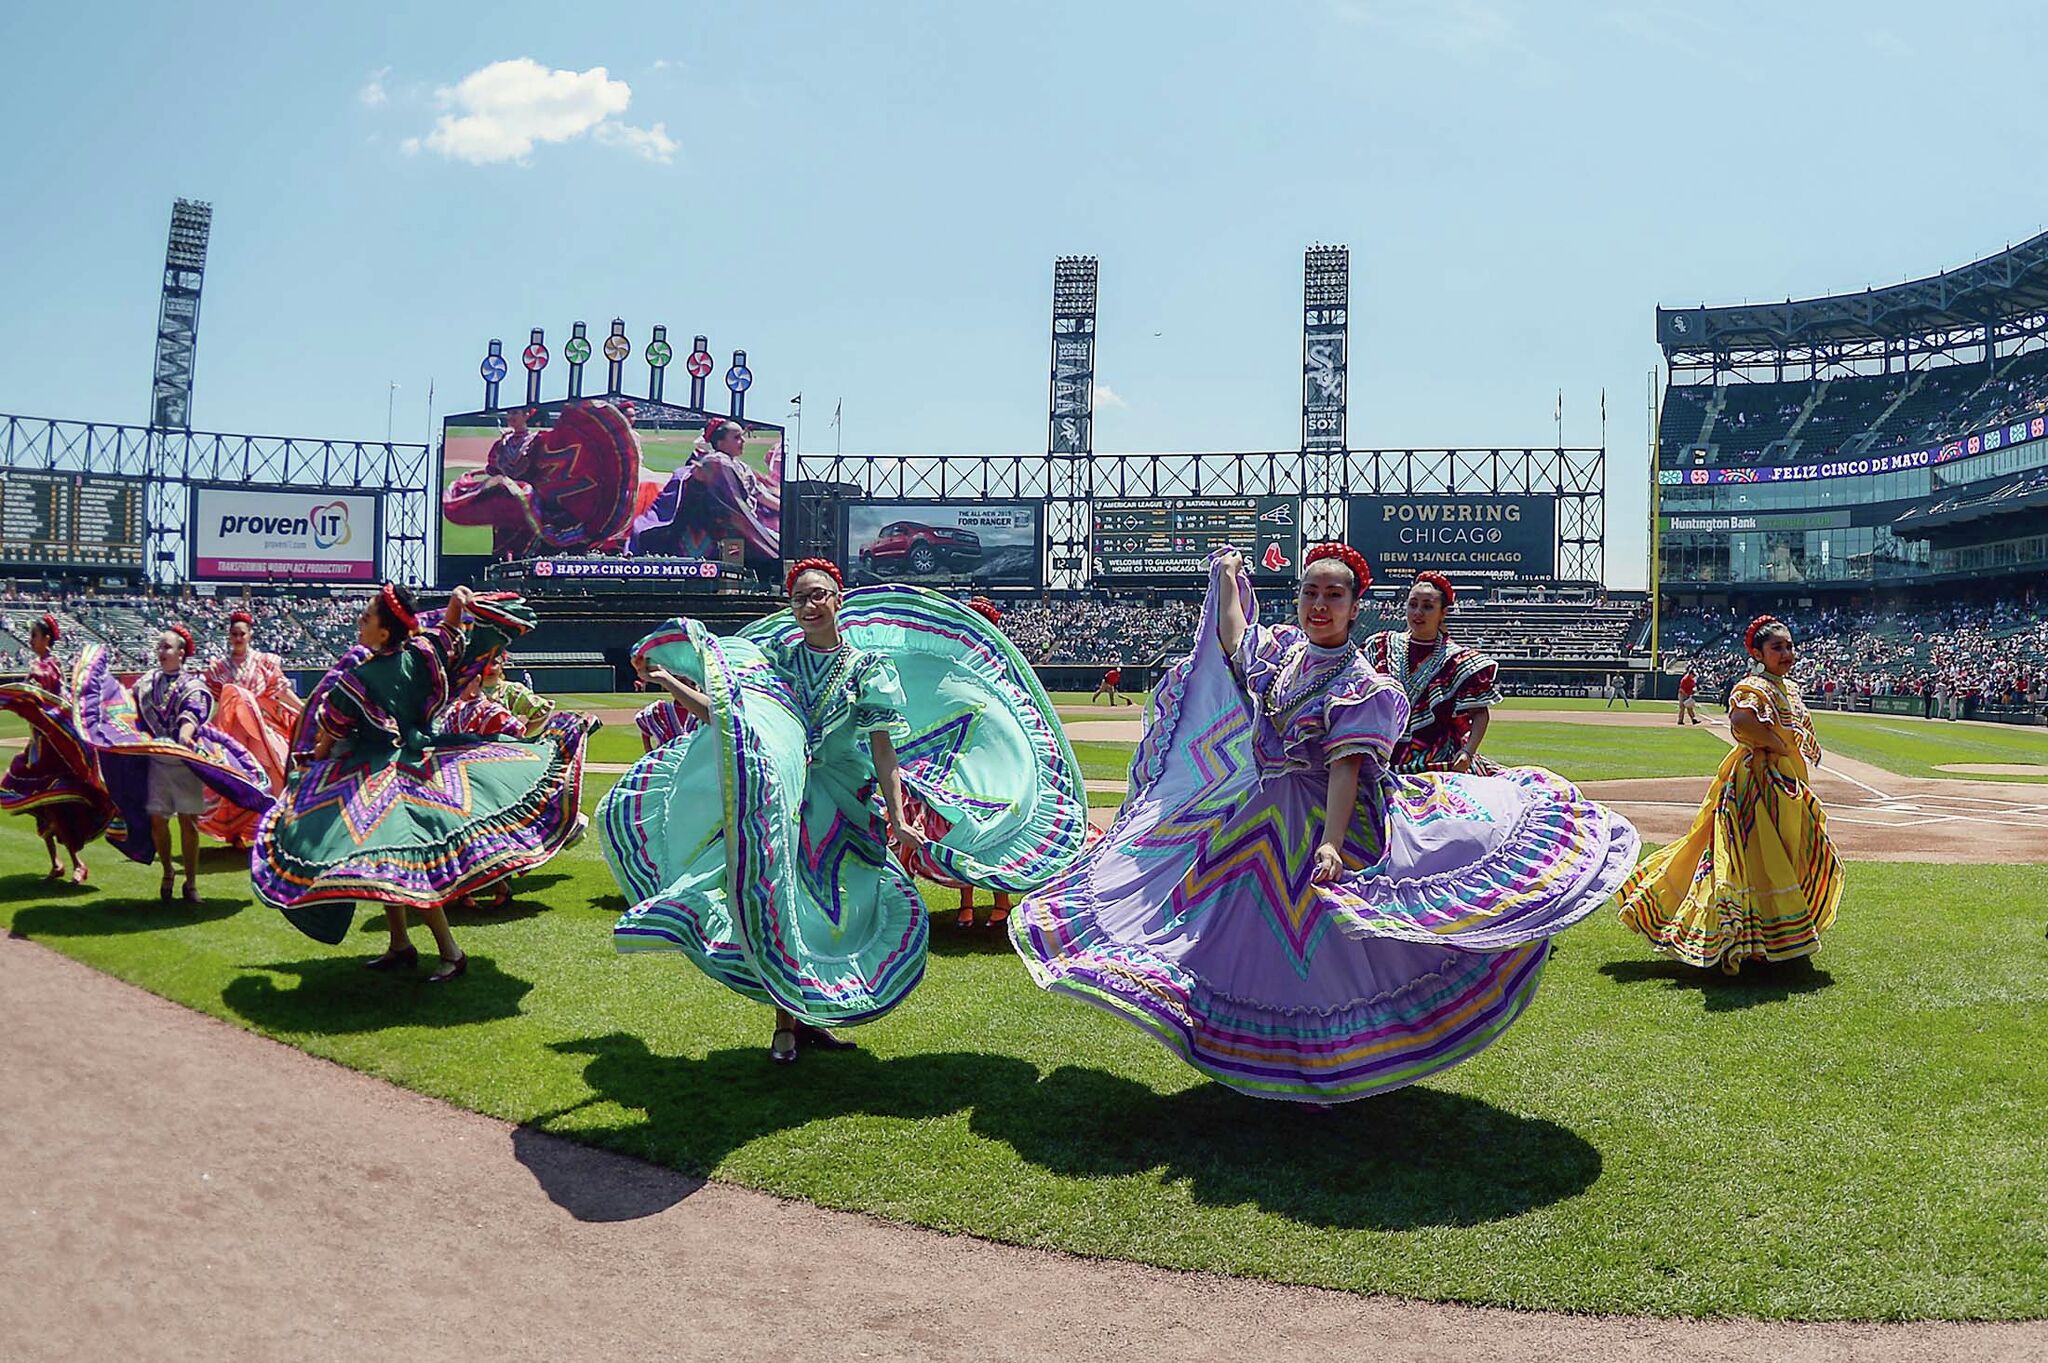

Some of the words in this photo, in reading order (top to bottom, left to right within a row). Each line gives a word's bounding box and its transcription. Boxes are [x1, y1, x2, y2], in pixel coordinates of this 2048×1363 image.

[1308, 419, 1337, 430] SOX
[1773, 466, 1817, 480] FELIZ
[1821, 461, 1868, 477] CINCO
[1872, 458, 1888, 472] DE
[1892, 451, 1929, 470] MAYO
[1383, 505, 1520, 521] POWERING
[219, 515, 308, 537] proven
[321, 515, 341, 536] IT
[958, 518, 979, 526] FORD
[980, 518, 1011, 526] RANGER
[1671, 517, 1731, 532] Huntington
[1731, 517, 1756, 528] Bank
[1400, 528, 1502, 543] CHICAGO
[1380, 552, 1408, 562] IBEW
[1411, 552, 1467, 562] 134/NECA
[1471, 552, 1522, 562] CHICAGO
[556, 565, 598, 575] HAPPY
[600, 565, 639, 575] CINCO
[643, 565, 659, 575] DE
[662, 565, 698, 576] MAYO
[1516, 688, 1562, 696] CHICAGO'S
[1565, 688, 1586, 696] BEER
